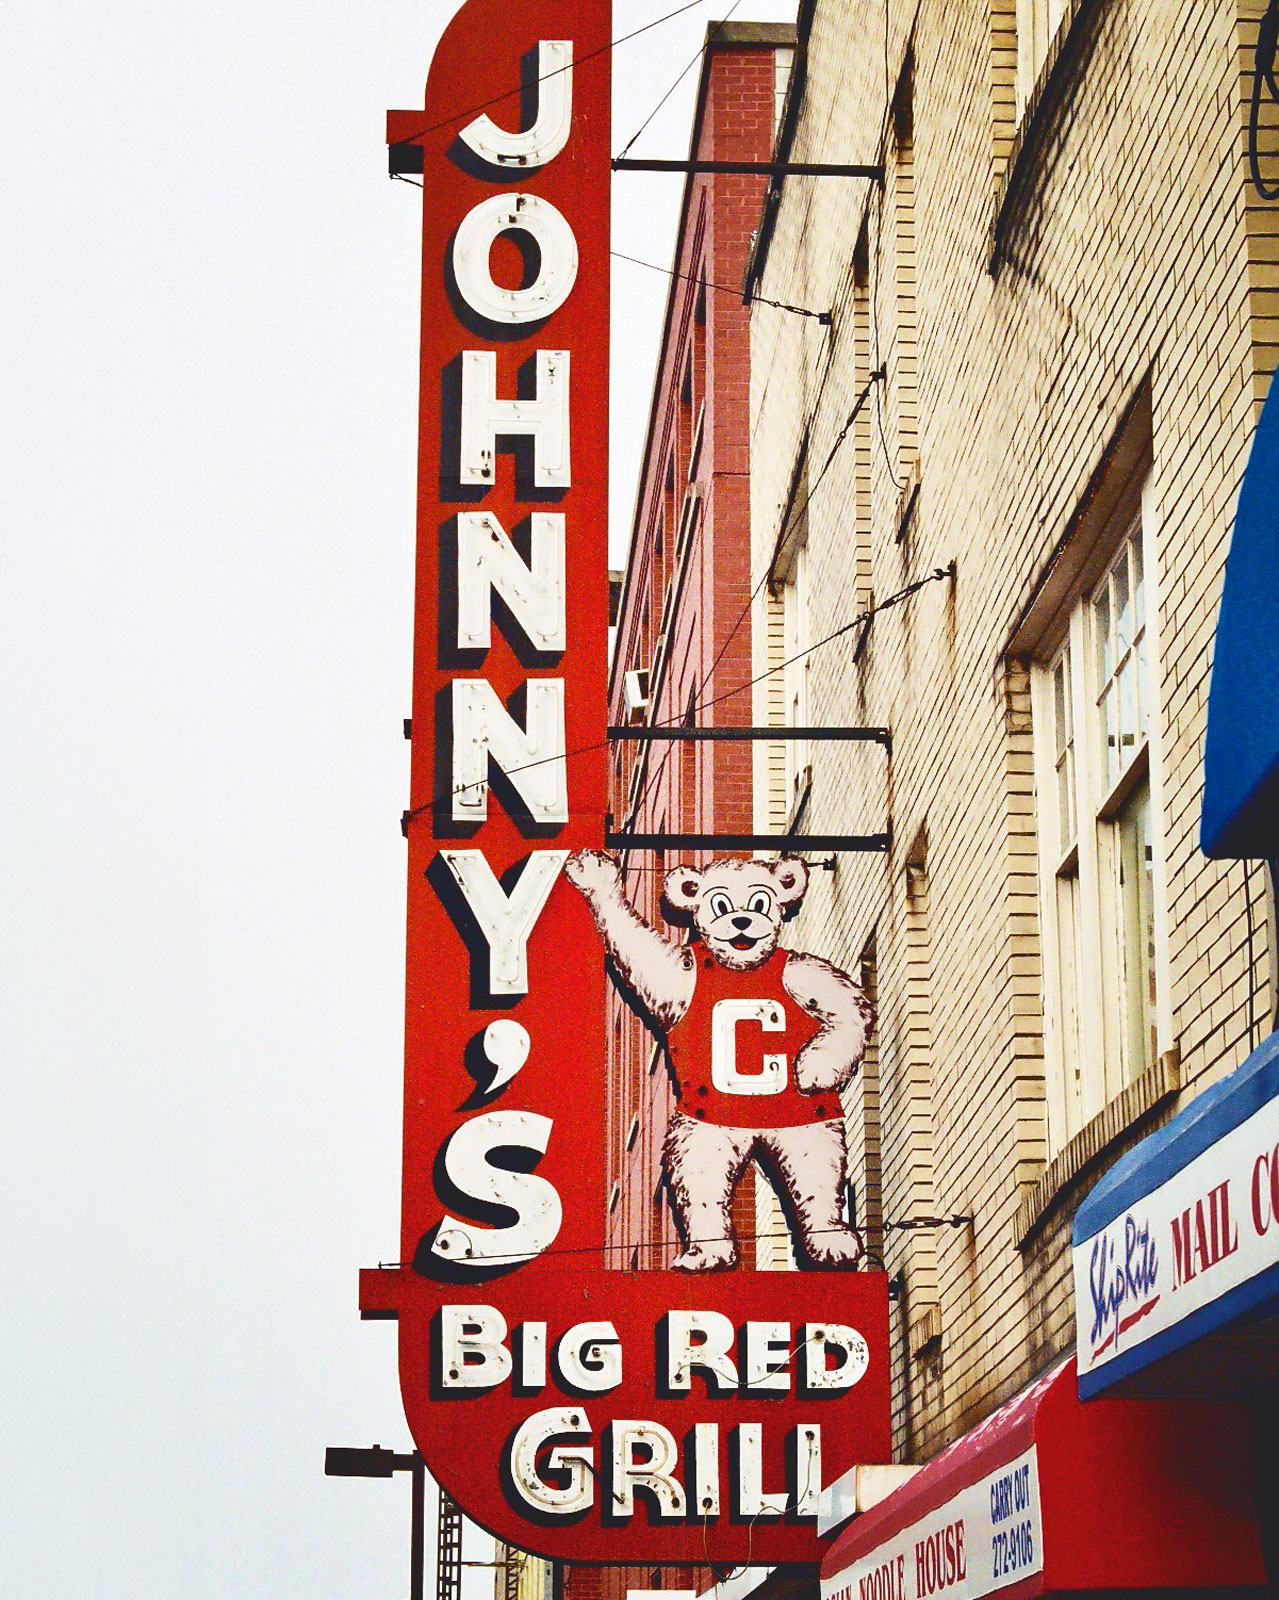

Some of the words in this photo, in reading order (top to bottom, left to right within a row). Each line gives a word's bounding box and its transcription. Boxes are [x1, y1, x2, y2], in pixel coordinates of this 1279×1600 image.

[431, 40, 578, 1267] JOHNNY'S
[712, 998, 788, 1096] C
[1170, 1179, 1239, 1292] MAIL
[441, 1304, 623, 1391] BIG
[668, 1310, 870, 1390] RED
[510, 1406, 822, 1517] GRILL
[989, 1474, 1013, 1525] CARRY
[1014, 1464, 1030, 1512] OUT
[915, 1519, 967, 1599] HOUSE
[992, 1519, 1033, 1578] 272-9106
